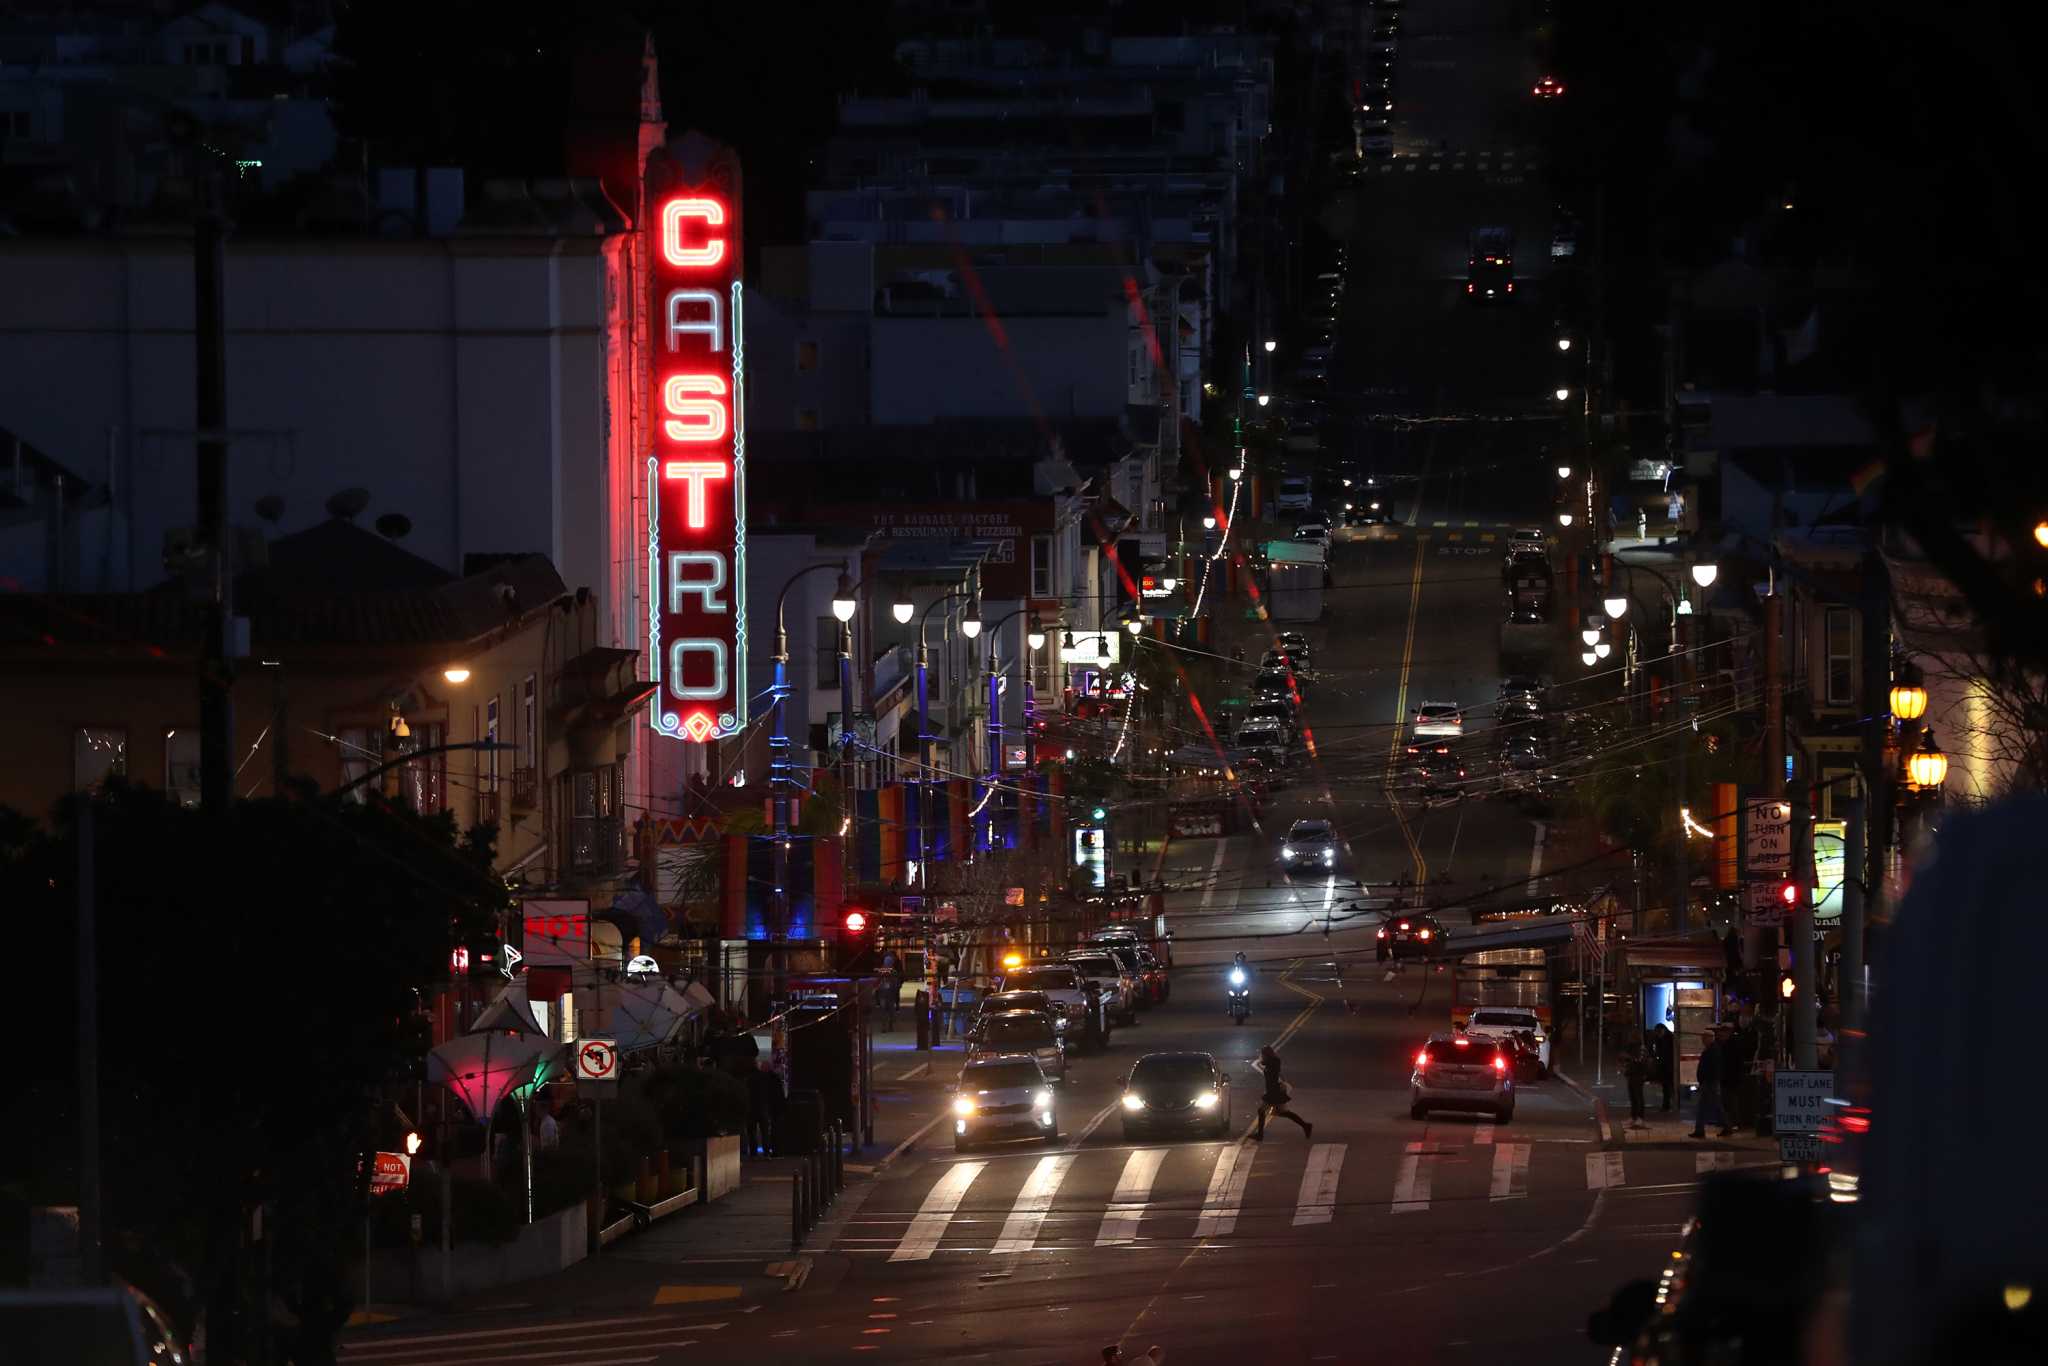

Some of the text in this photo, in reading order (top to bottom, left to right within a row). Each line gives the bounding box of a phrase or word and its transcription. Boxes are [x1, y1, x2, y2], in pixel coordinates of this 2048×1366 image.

[663, 199, 728, 701] CASTRO
[1756, 807, 1782, 820] NO
[1754, 823, 1784, 835] TURN
[1760, 839, 1777, 850] ON
[1777, 1079, 1833, 1089] RIGHT LANE
[1788, 1096, 1822, 1108] MUST
[1777, 1115, 1802, 1125] TURN
[383, 1163, 401, 1172] NOT
